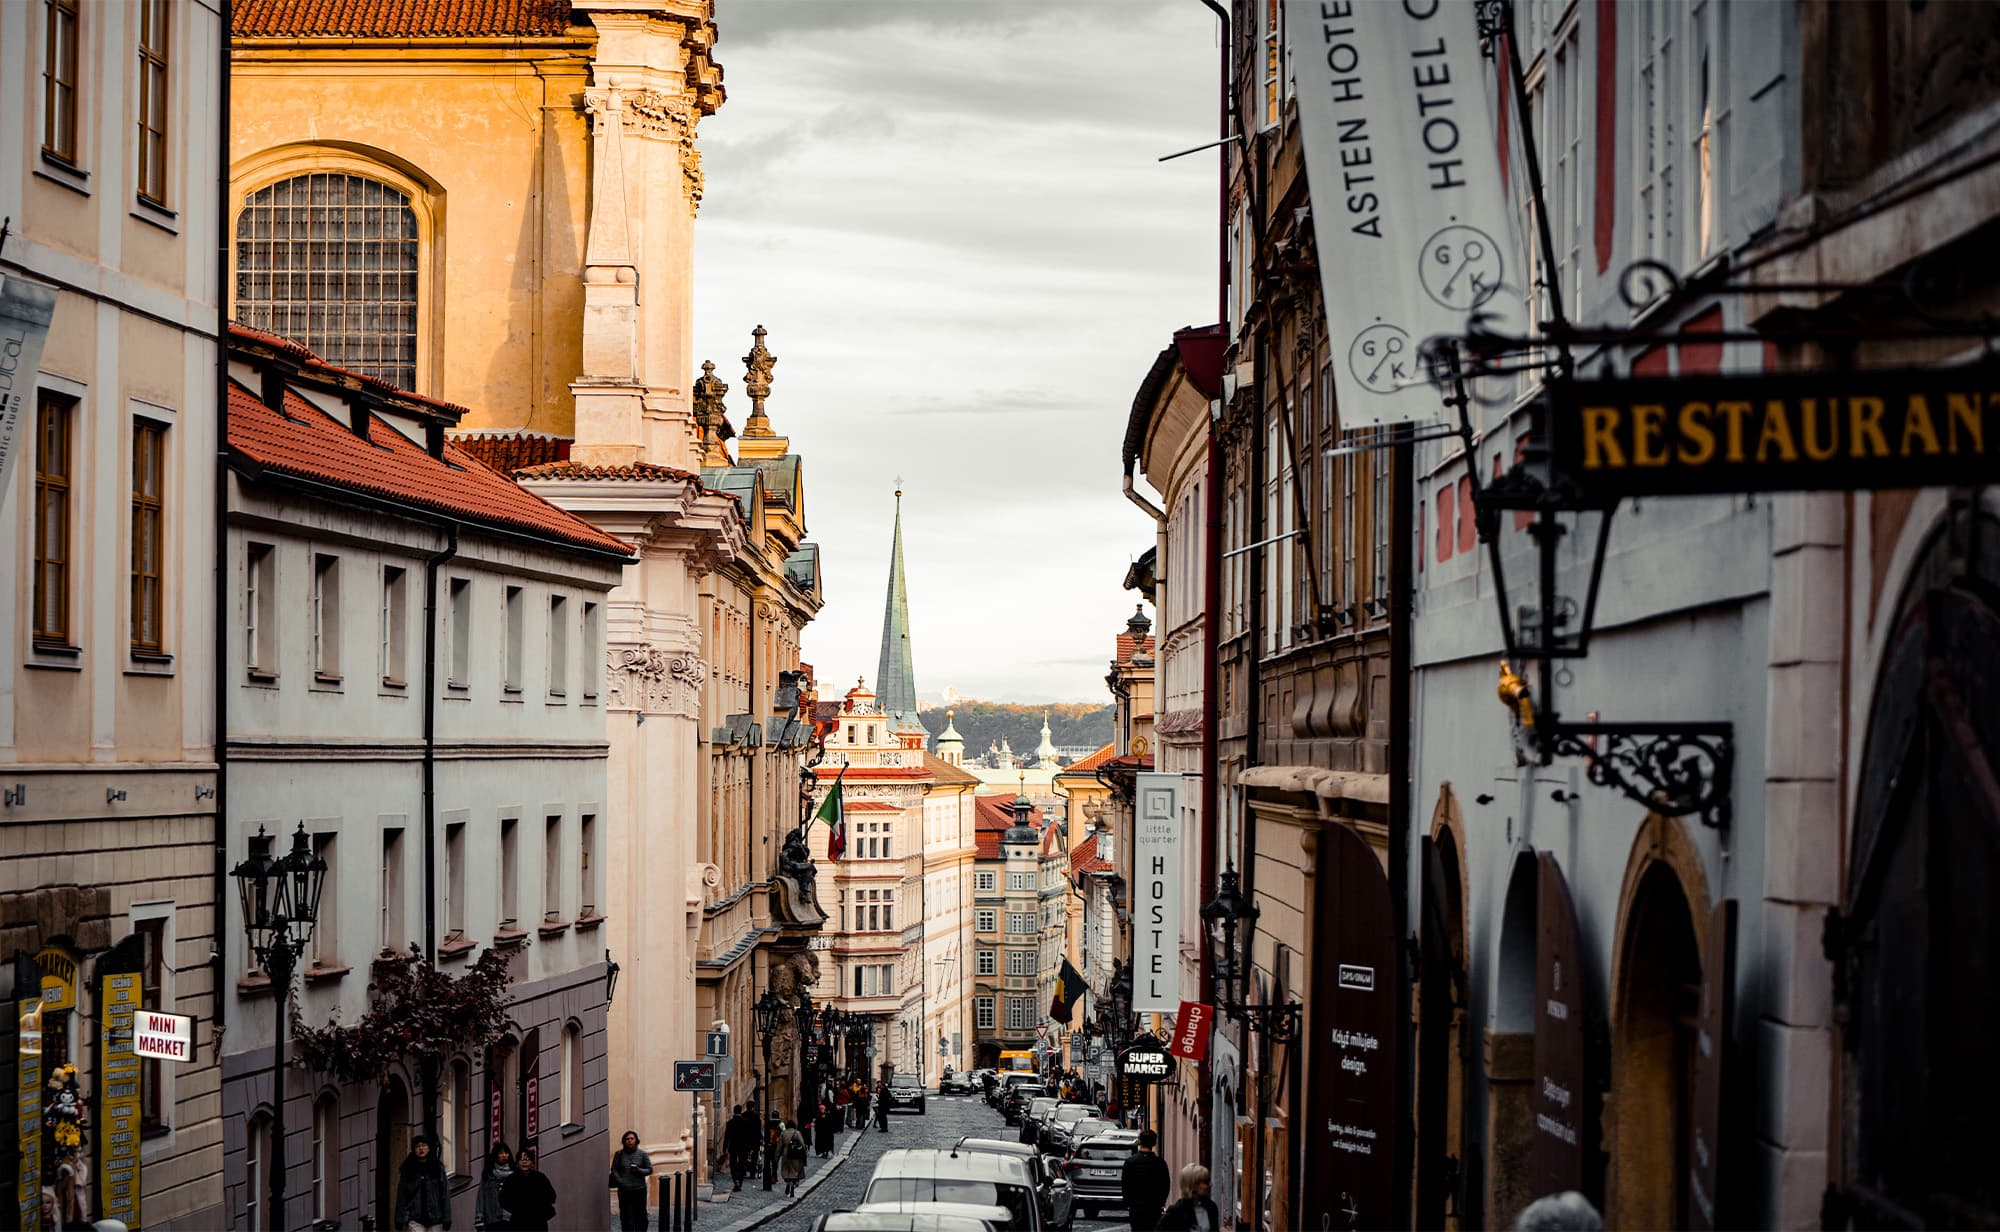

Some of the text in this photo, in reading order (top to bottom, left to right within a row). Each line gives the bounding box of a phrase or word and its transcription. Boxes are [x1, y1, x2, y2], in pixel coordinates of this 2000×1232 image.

[1411, 38, 1467, 191] HOTEL
[1337, 118, 1383, 239] ASTEN
[6, 394, 22, 432] studio
[1581, 392, 2000, 470] RESTAURAN
[1139, 836, 1177, 846] quarter
[1146, 824, 1172, 834] little
[1150, 855, 1165, 999] HOSTEL
[149, 1015, 176, 1034] MINI
[1181, 1006, 1202, 1053] change
[139, 1035, 185, 1057] MARKET
[1129, 1052, 1164, 1063] SUPER
[1124, 1063, 1168, 1074] MARKET
